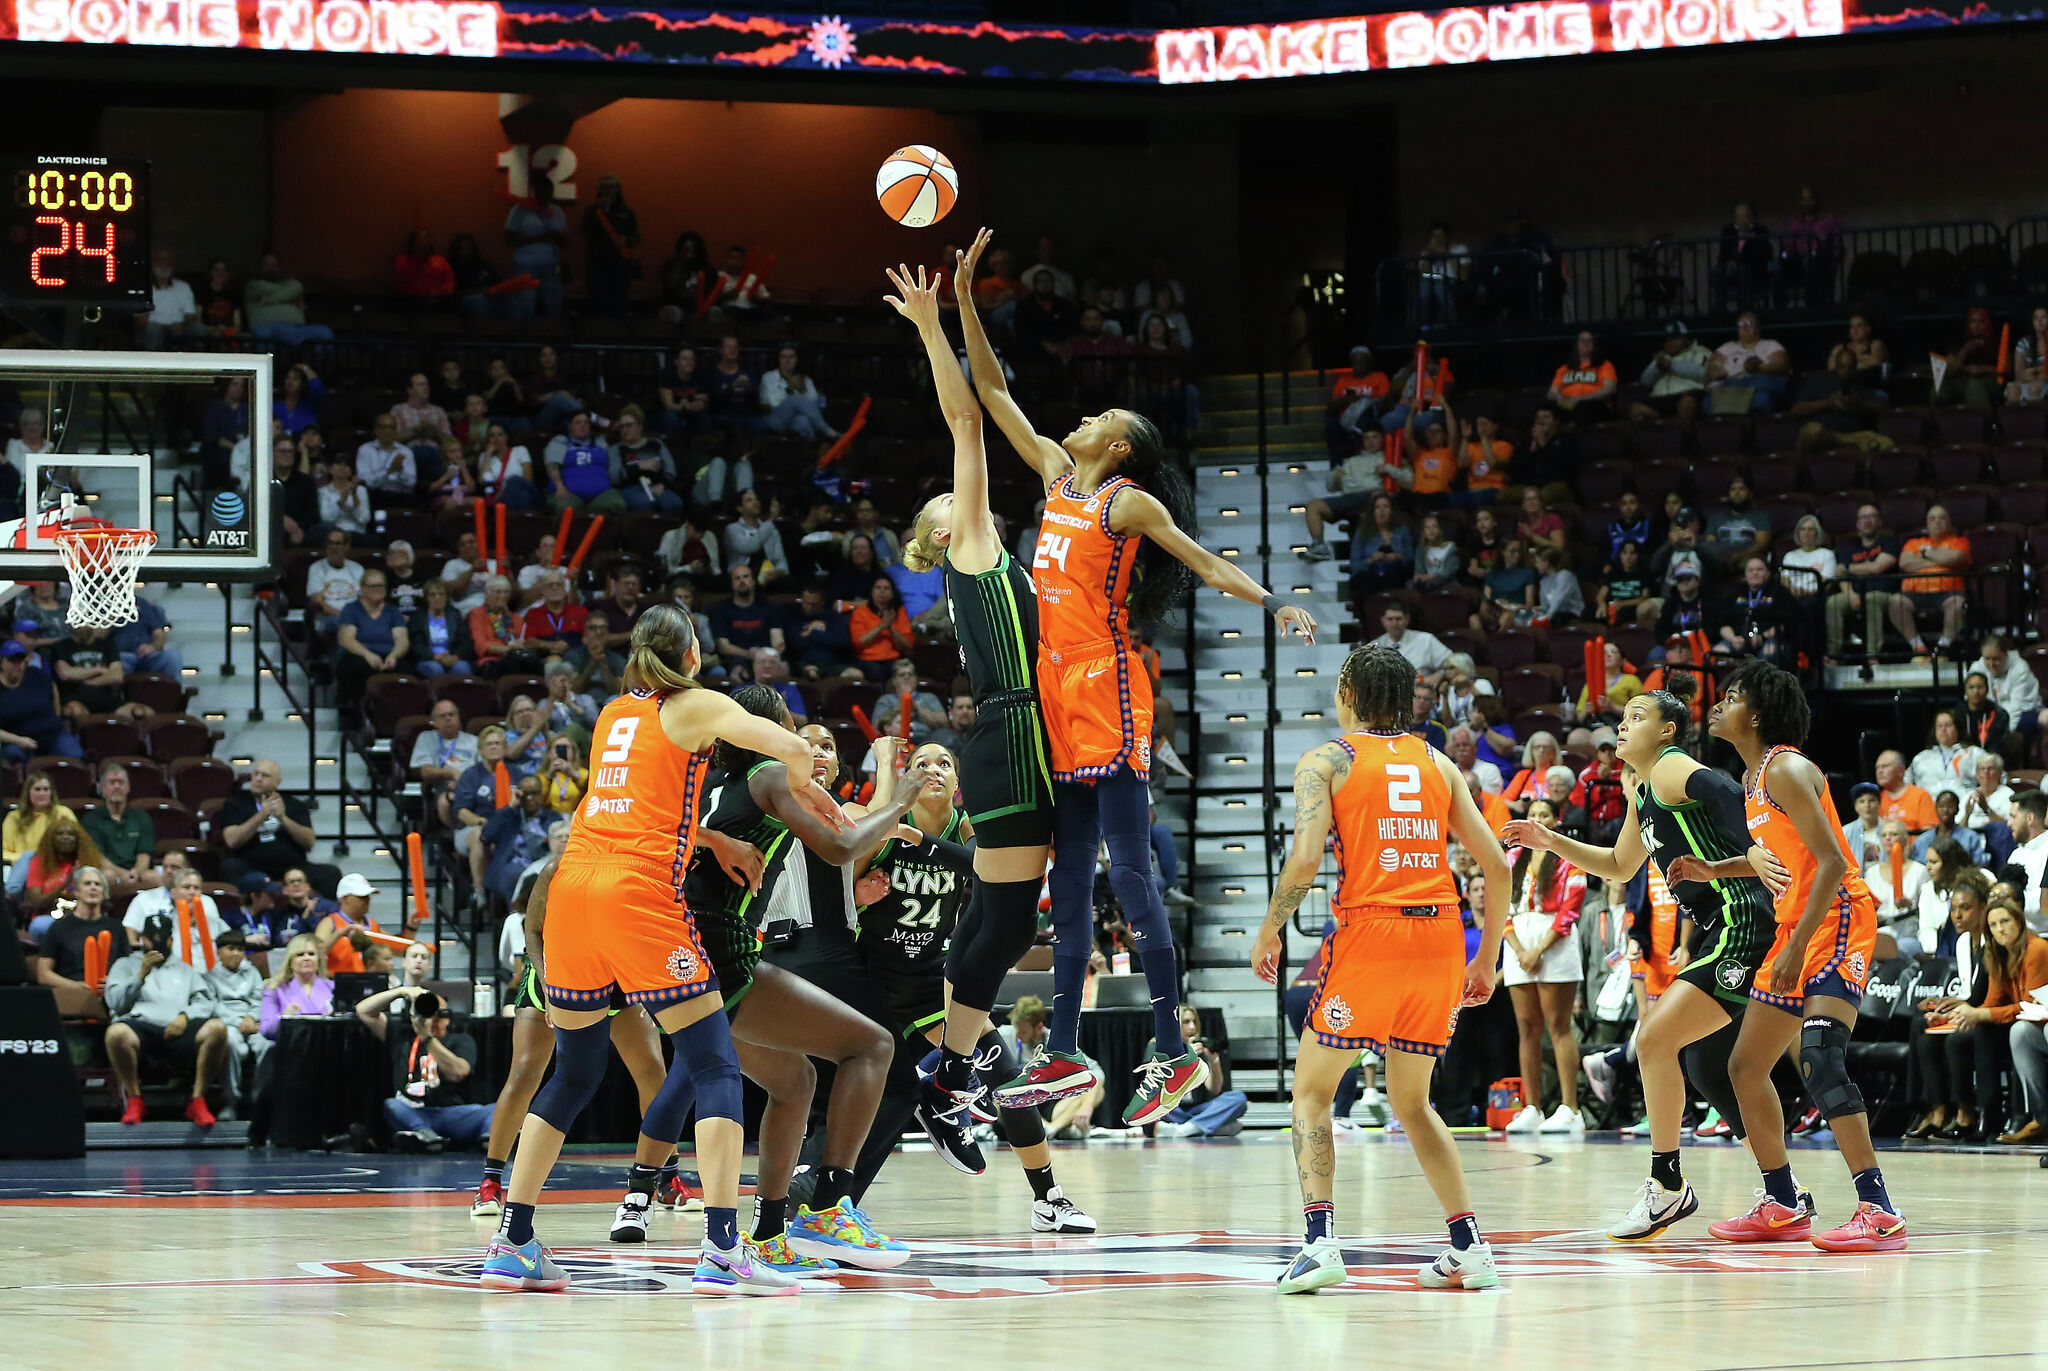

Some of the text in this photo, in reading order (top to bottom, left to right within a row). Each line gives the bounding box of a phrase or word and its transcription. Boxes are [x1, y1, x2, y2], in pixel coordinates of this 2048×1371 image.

[17, 0, 497, 57] SOME NOISE
[1157, 0, 1843, 84] MAKE SOME NOISE
[38, 156, 108, 165] DAKTRONICS
[497, 145, 577, 199] 12
[28, 170, 133, 212] 10:00
[31, 216, 115, 286] 24
[1042, 510, 1093, 530] ONNECTICUT
[206, 530, 249, 546] AT&T
[1033, 532, 1072, 573] 24
[601, 717, 640, 763] 9
[595, 767, 629, 789] ALLEN
[1385, 764, 1422, 813] 2
[600, 798, 634, 814] AT&T
[1377, 818, 1439, 841] HIEDEMAN
[894, 859, 945, 872] MINNESO
[1401, 853, 1440, 869] AT&T
[891, 866, 956, 895] LYNX
[897, 898, 942, 929] 24
[891, 928, 934, 941] MAYO
